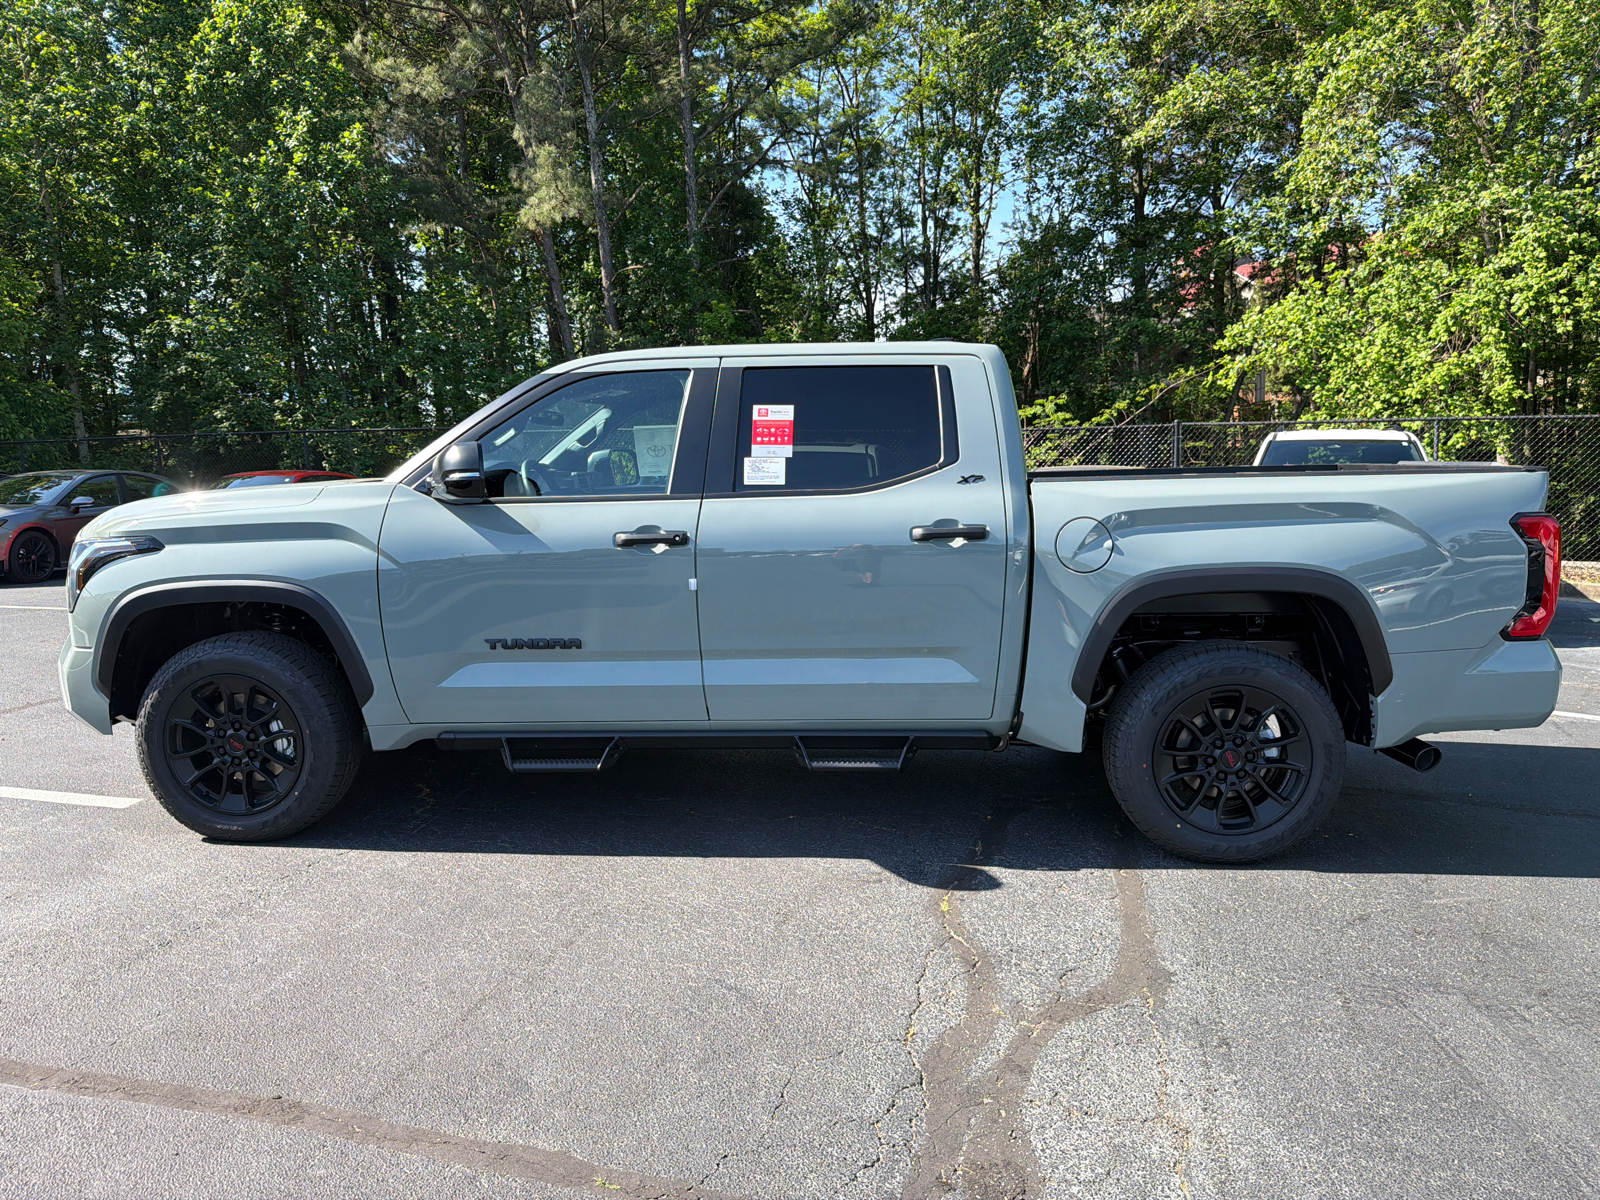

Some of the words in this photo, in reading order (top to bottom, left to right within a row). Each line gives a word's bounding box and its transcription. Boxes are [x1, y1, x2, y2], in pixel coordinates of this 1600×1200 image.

[484, 638, 582, 650] TUNDRA
[229, 738, 245, 750] TRD
[1225, 750, 1235, 768] TRD
